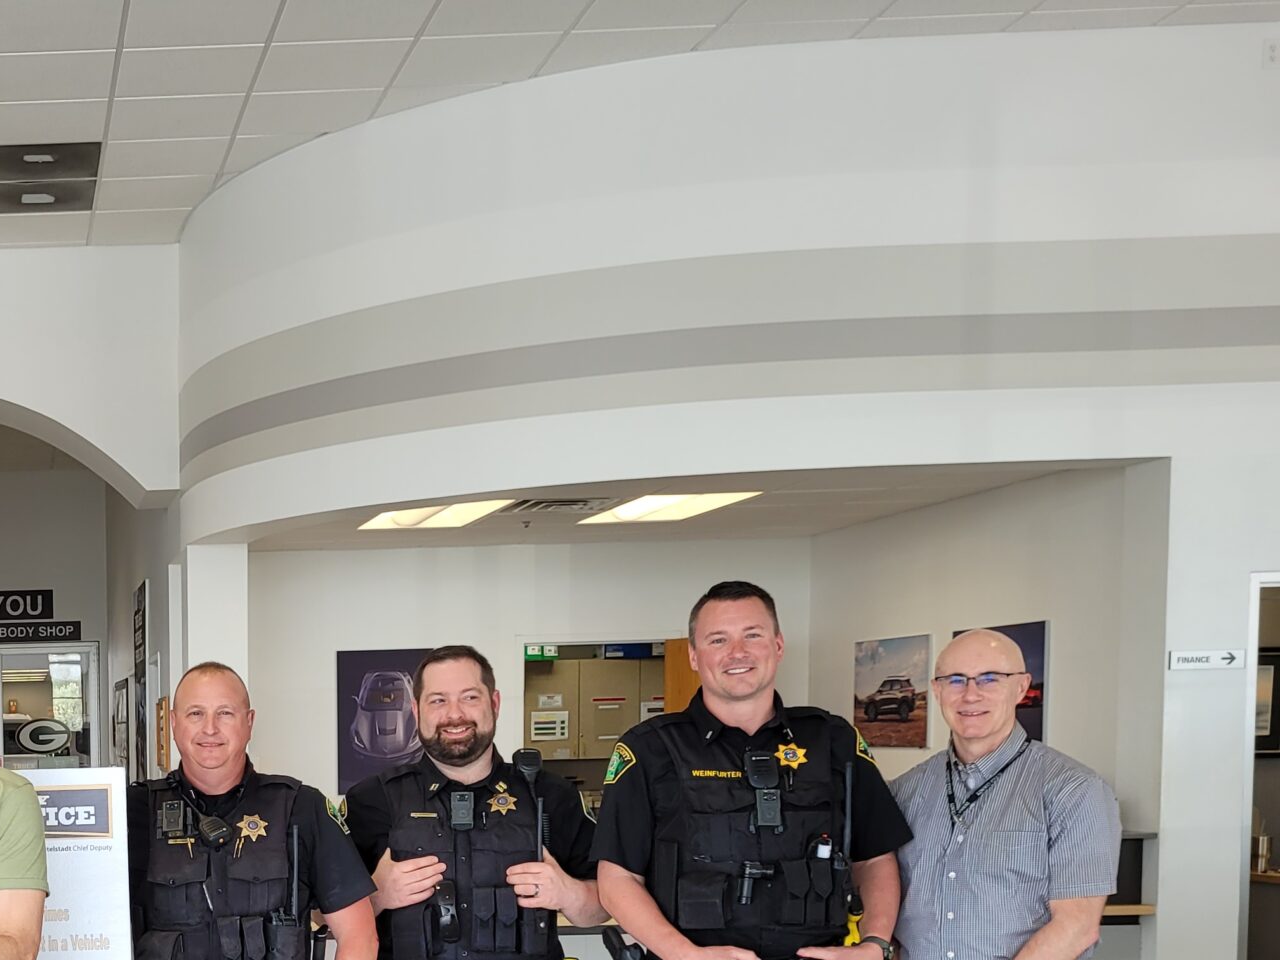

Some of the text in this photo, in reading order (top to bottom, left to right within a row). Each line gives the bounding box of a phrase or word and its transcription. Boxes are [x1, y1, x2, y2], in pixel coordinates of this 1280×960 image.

[39, 625, 74, 637] SHOP
[1177, 656, 1211, 664] FINANCE
[692, 769, 742, 779] WEINFURTER
[89, 844, 113, 852] Deputy
[48, 935, 59, 952] in
[60, 938, 68, 951] a
[70, 933, 110, 951] Vehicle
